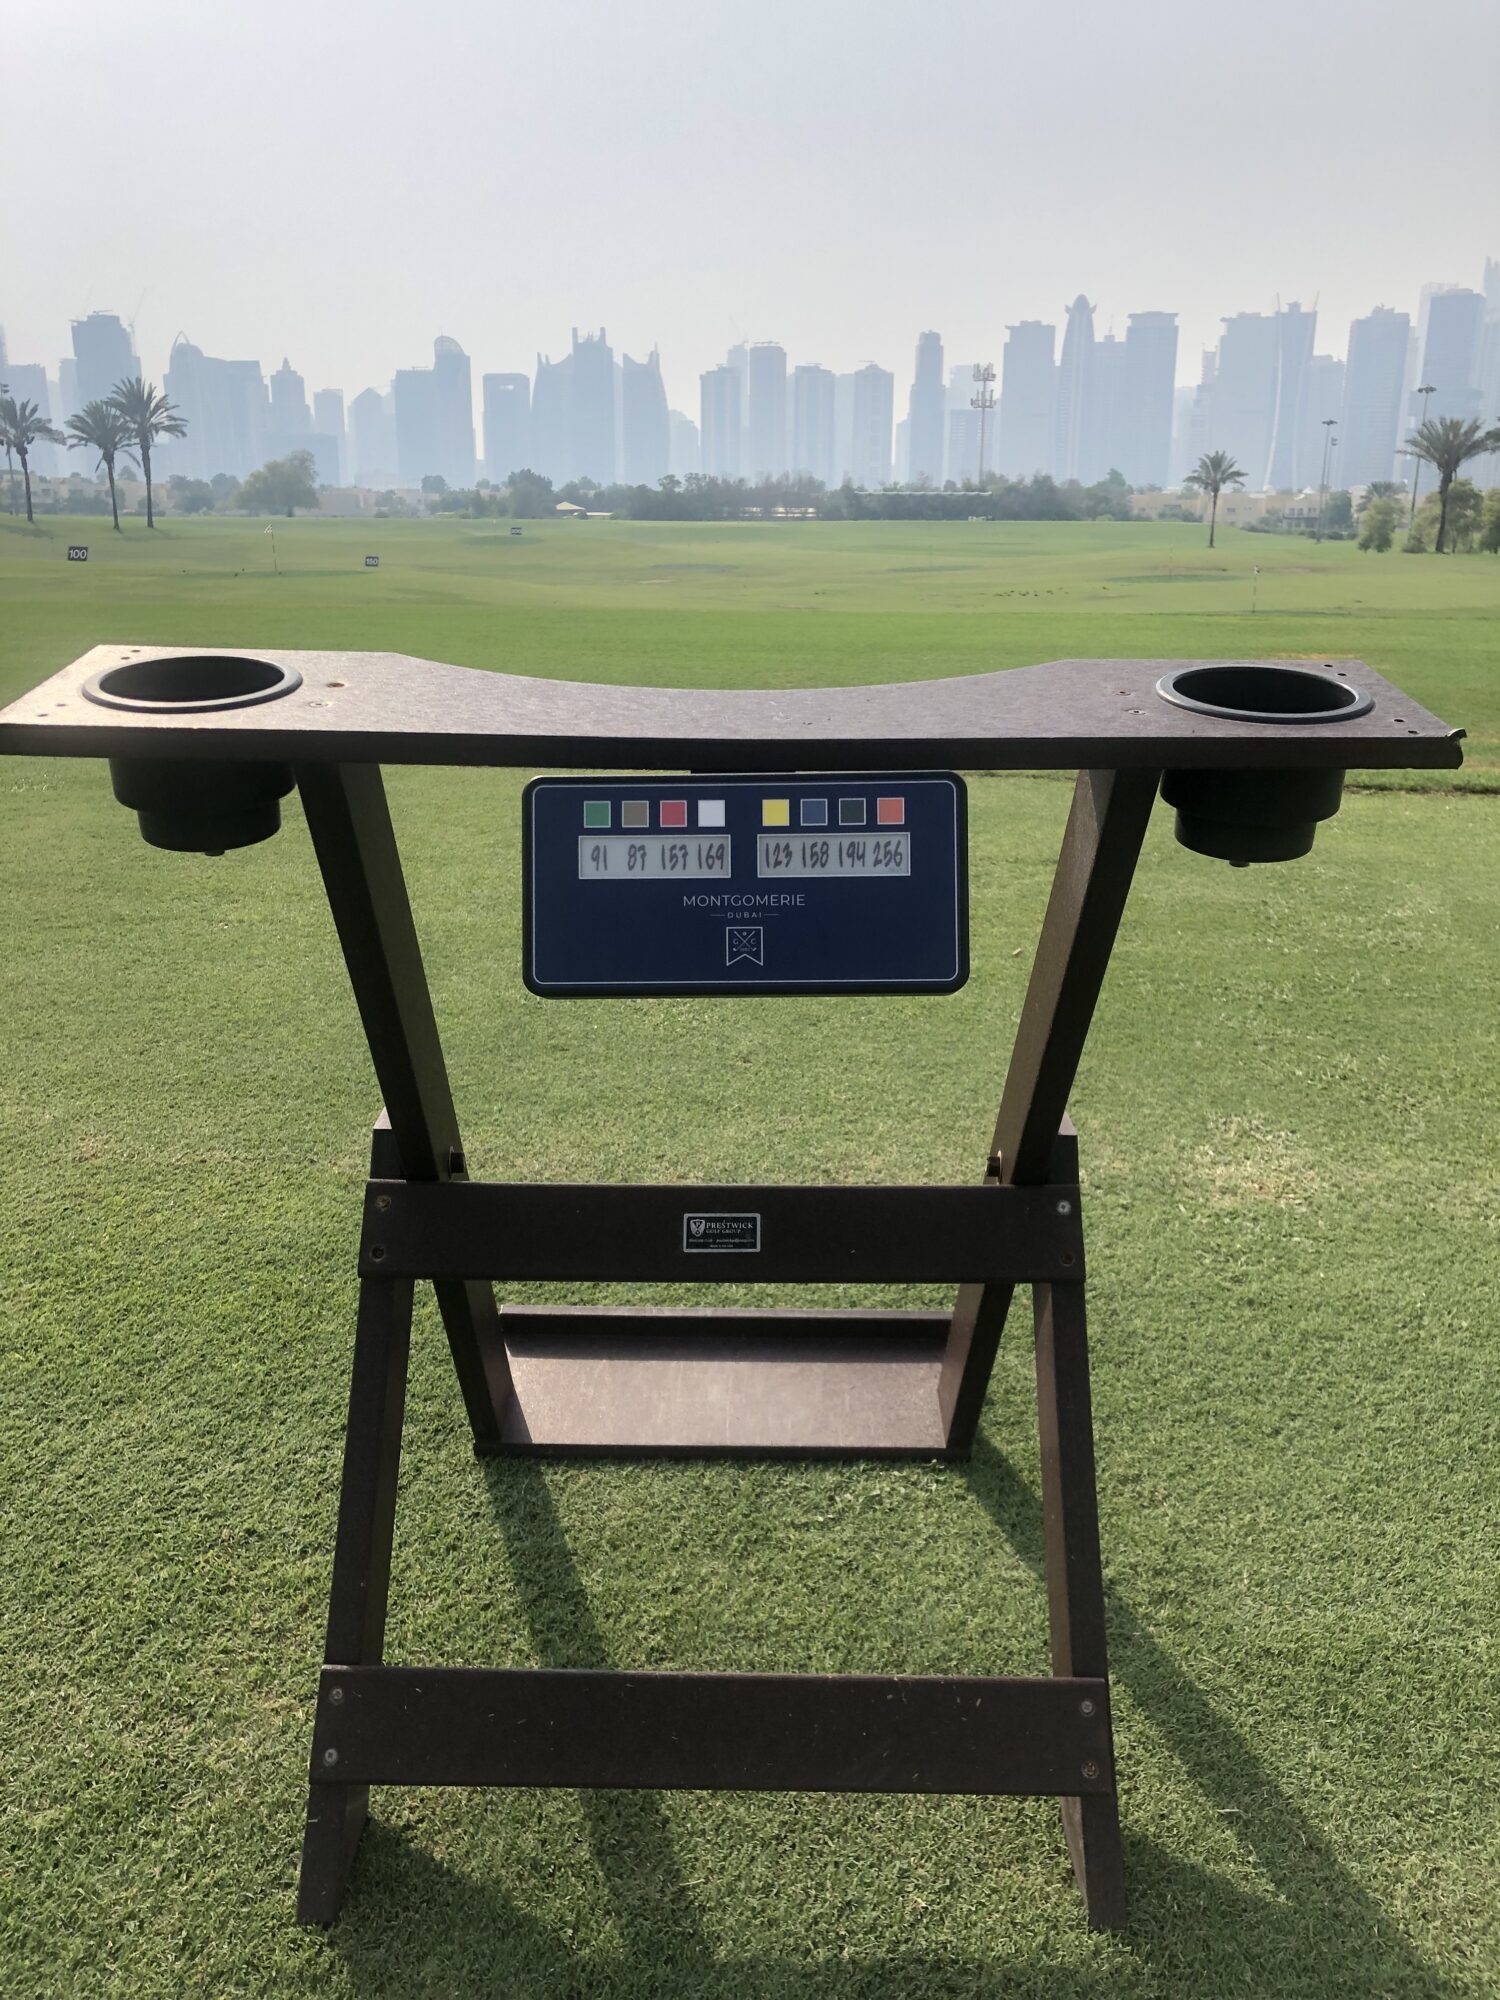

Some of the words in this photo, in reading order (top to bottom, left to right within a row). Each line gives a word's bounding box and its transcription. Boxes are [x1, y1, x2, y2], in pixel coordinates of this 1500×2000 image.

[69, 549, 87, 559] 100
[591, 844, 608, 871] 91
[627, 843, 647, 871] 87
[661, 843, 689, 871] 157
[697, 842, 725, 870] 169
[765, 841, 793, 868] 123
[801, 841, 829, 868] 158
[838, 840, 866, 868] 194
[873, 839, 903, 867] 256
[683, 894, 806, 907] MONTGOMERIE
[727, 911, 762, 919] DUBAI
